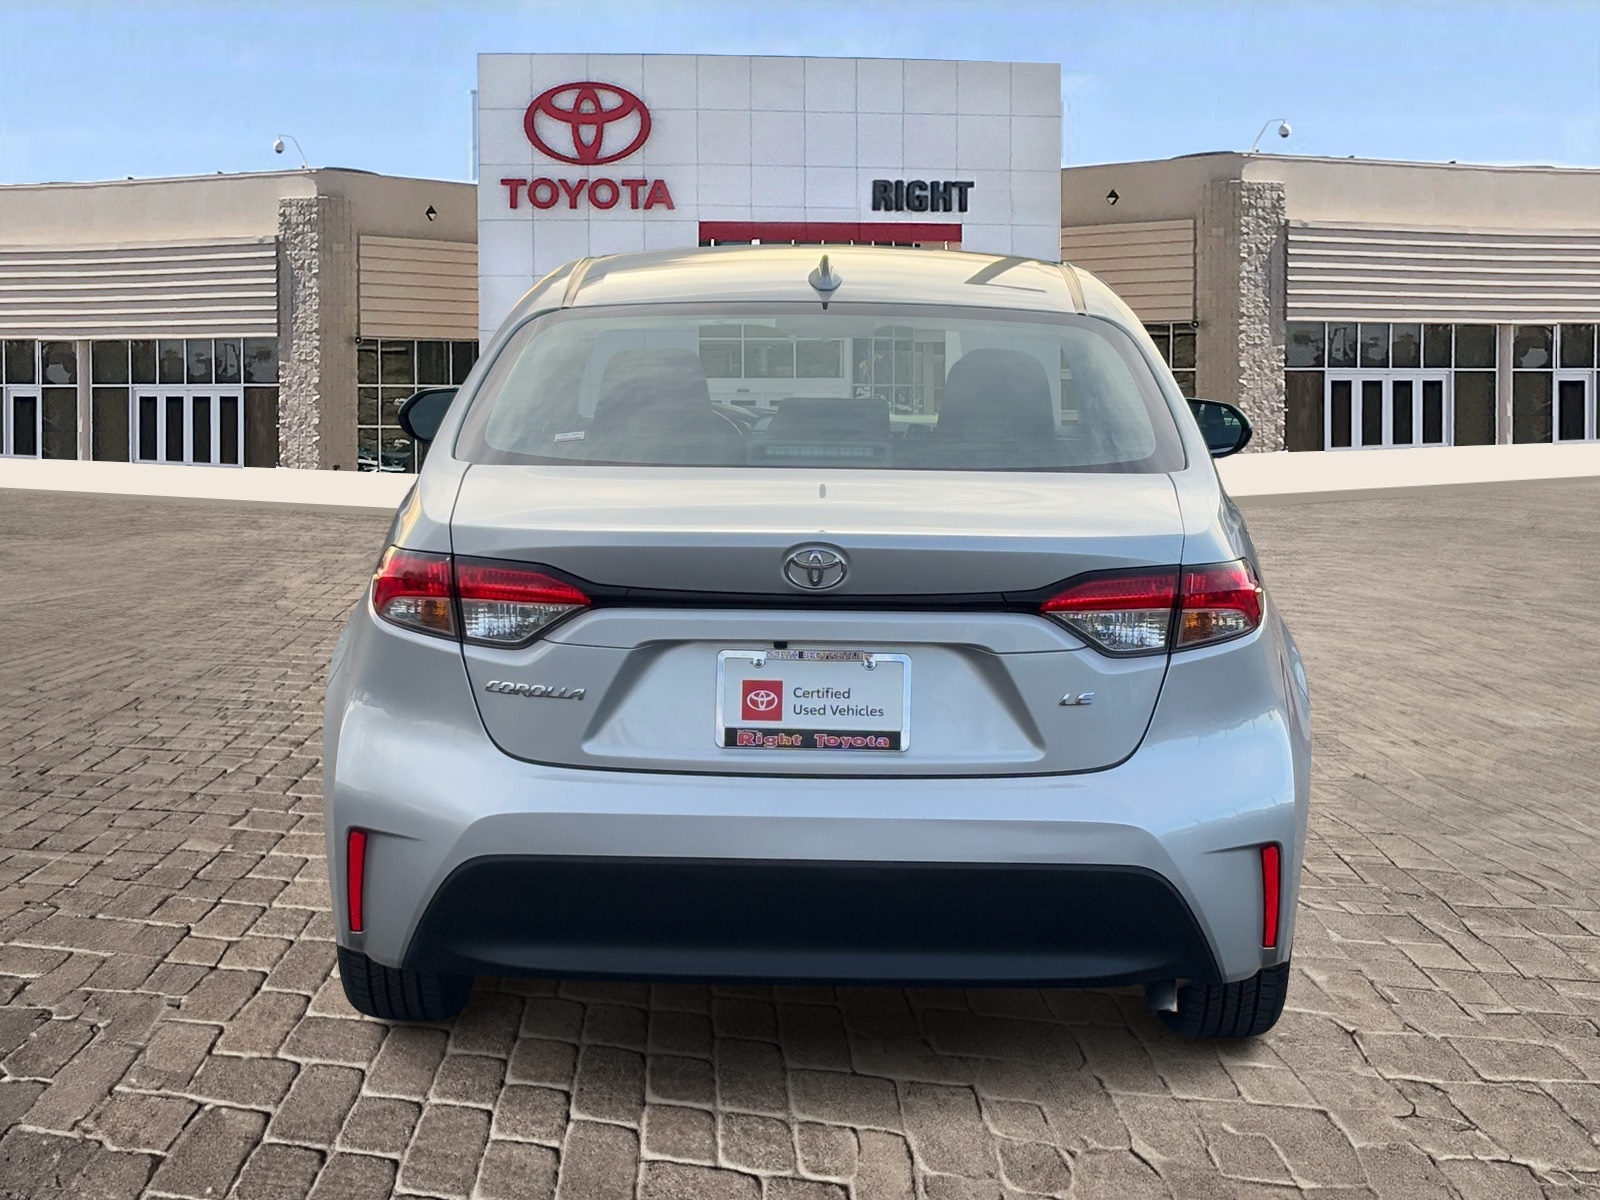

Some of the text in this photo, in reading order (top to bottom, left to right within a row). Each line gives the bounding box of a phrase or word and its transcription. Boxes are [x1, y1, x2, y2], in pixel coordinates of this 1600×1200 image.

[500, 178, 675, 210] TOYOTA
[872, 179, 975, 212] RIGHT
[485, 680, 586, 700] COROLLA
[793, 687, 851, 699] Certified
[1059, 692, 1094, 706] LE
[793, 704, 884, 717] Used Vehicles
[736, 731, 890, 749] Right Toyota
